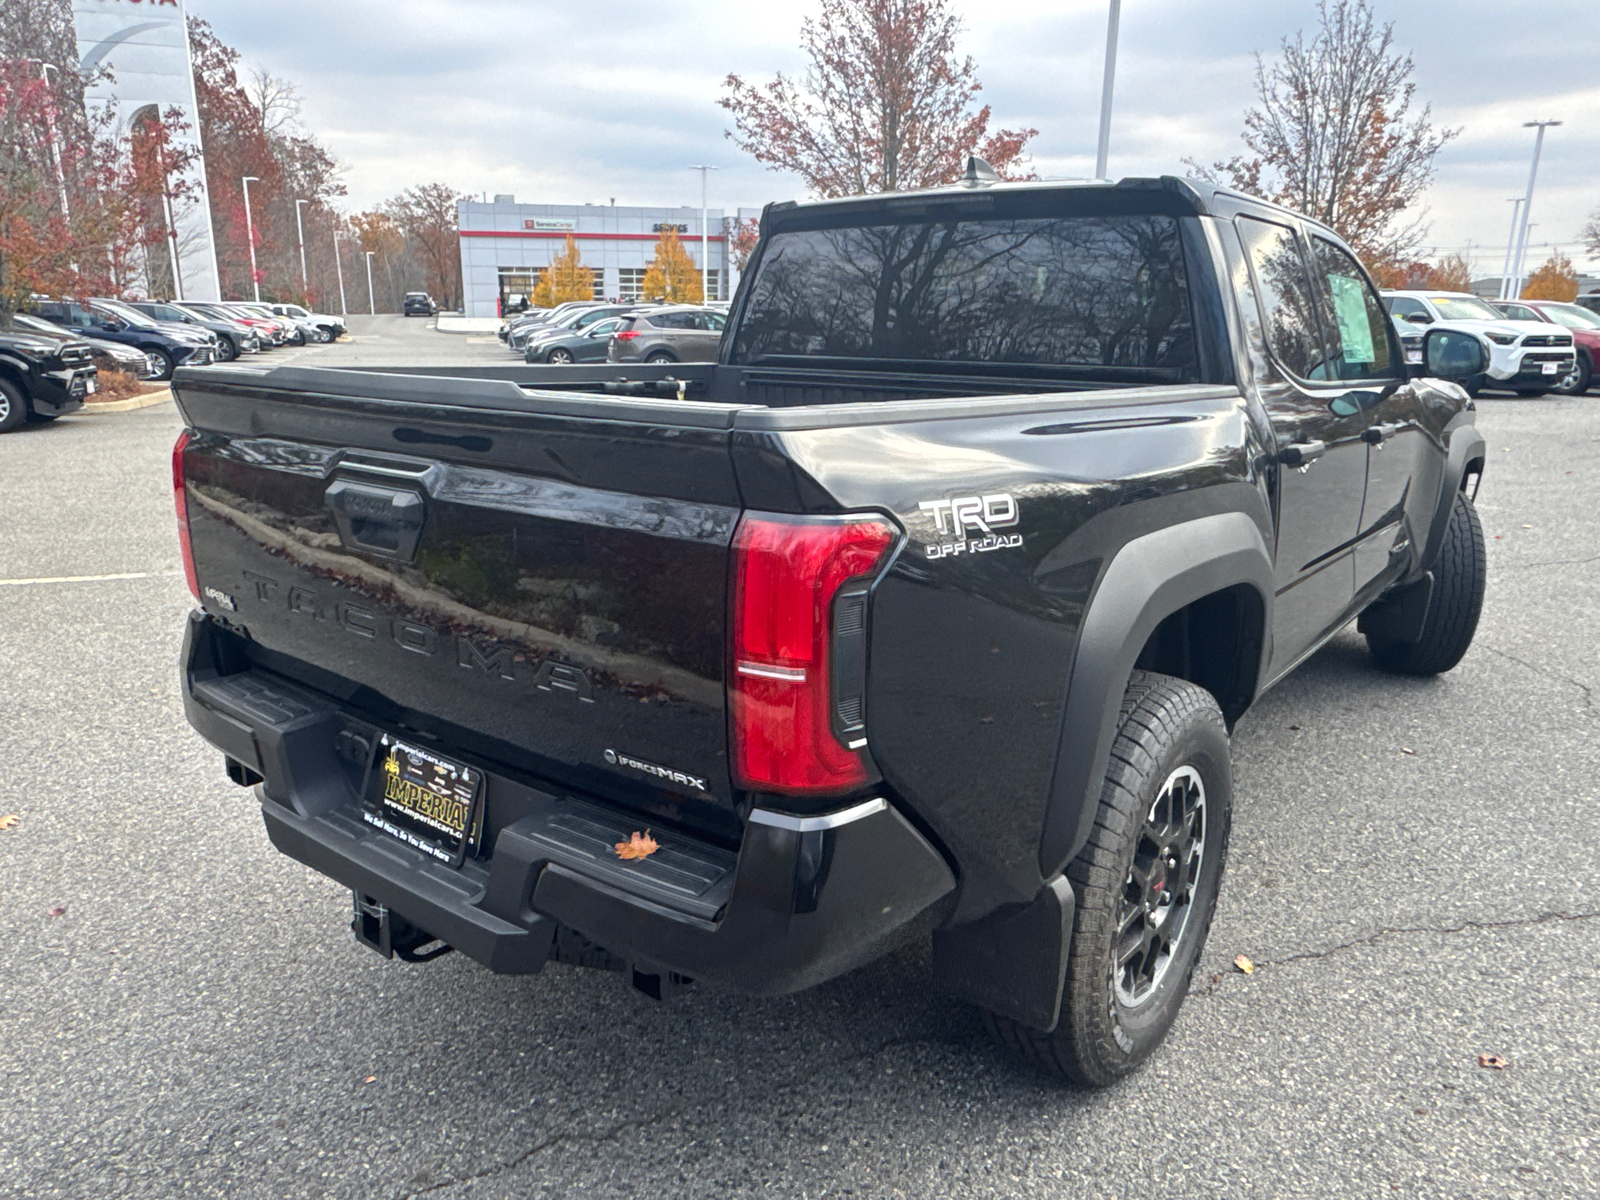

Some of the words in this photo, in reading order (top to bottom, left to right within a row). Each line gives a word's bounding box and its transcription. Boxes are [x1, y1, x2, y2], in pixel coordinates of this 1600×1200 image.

[652, 222, 688, 233] SEVCE
[918, 494, 1017, 537] TRD
[925, 541, 967, 559] OFF
[969, 534, 1023, 553] ROAD
[243, 570, 595, 704] TACOMA
[384, 798, 474, 845] www.imperialcars.cm
